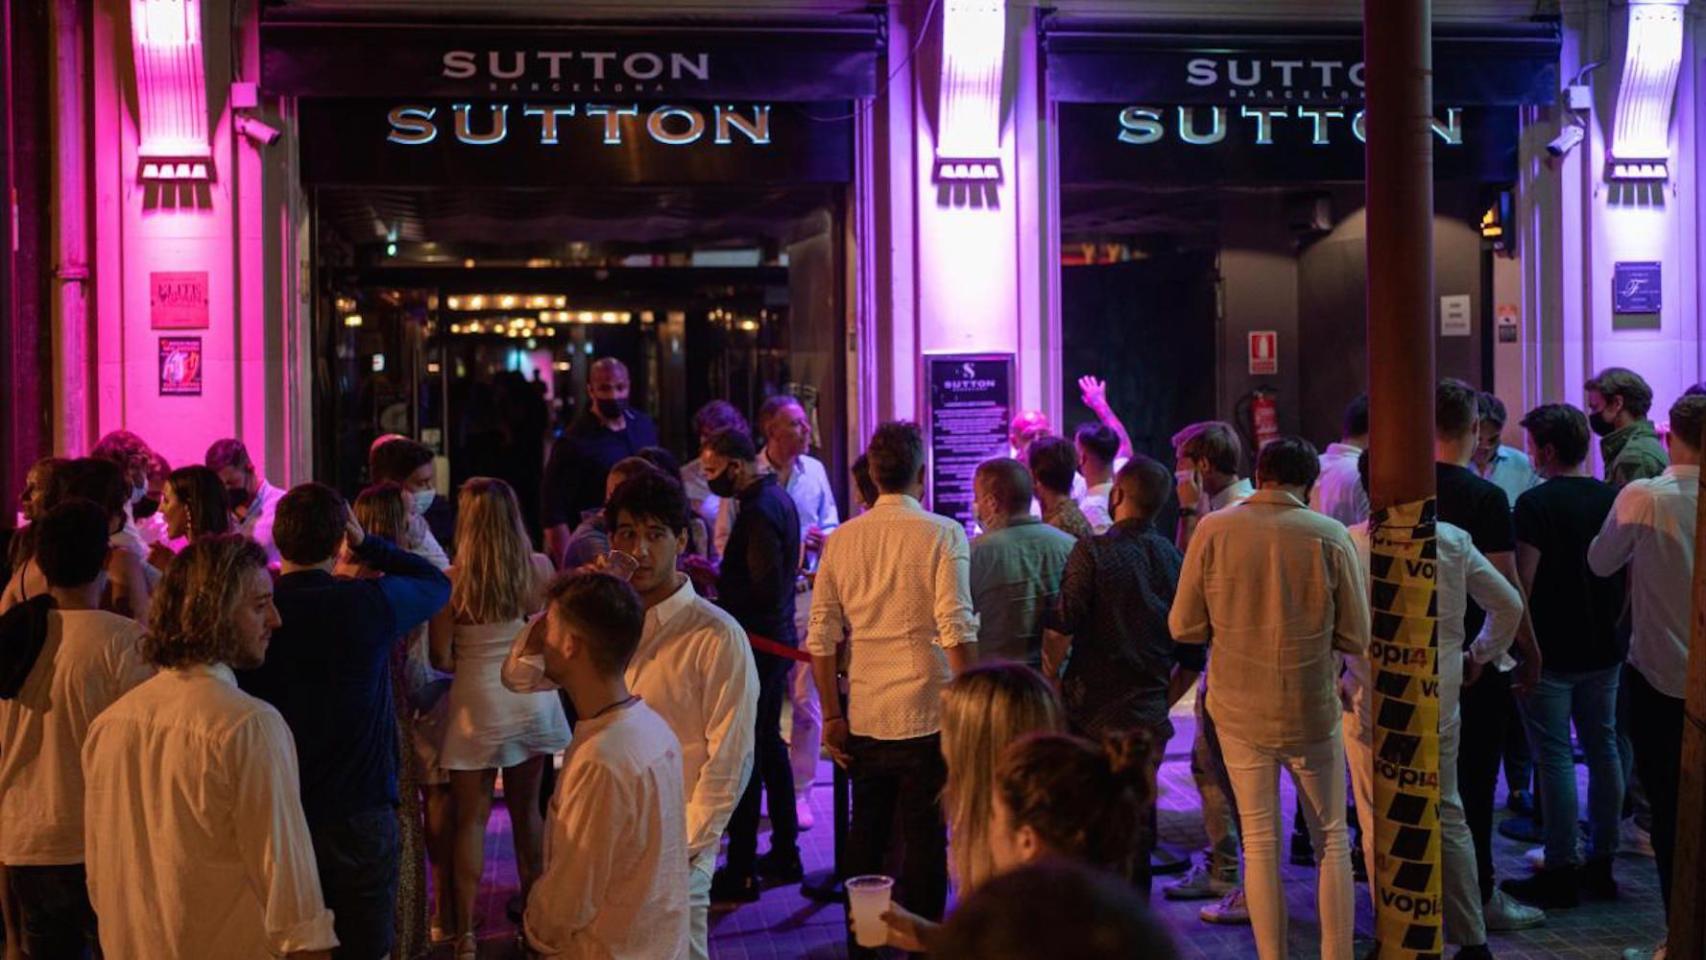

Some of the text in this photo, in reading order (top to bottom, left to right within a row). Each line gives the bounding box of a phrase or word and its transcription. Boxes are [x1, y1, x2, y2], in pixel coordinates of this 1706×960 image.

[442, 50, 710, 80] SUTTON
[1186, 58, 1365, 87] SUTT
[489, 82, 664, 92] BARCELONA
[1228, 89, 1365, 99] BARCELO
[386, 104, 772, 145] SUTTON
[1117, 105, 1464, 145] SUTTN
[943, 380, 996, 389] SUTTON
[1369, 641, 1427, 669] opi4
[1381, 887, 1441, 920] vopi
